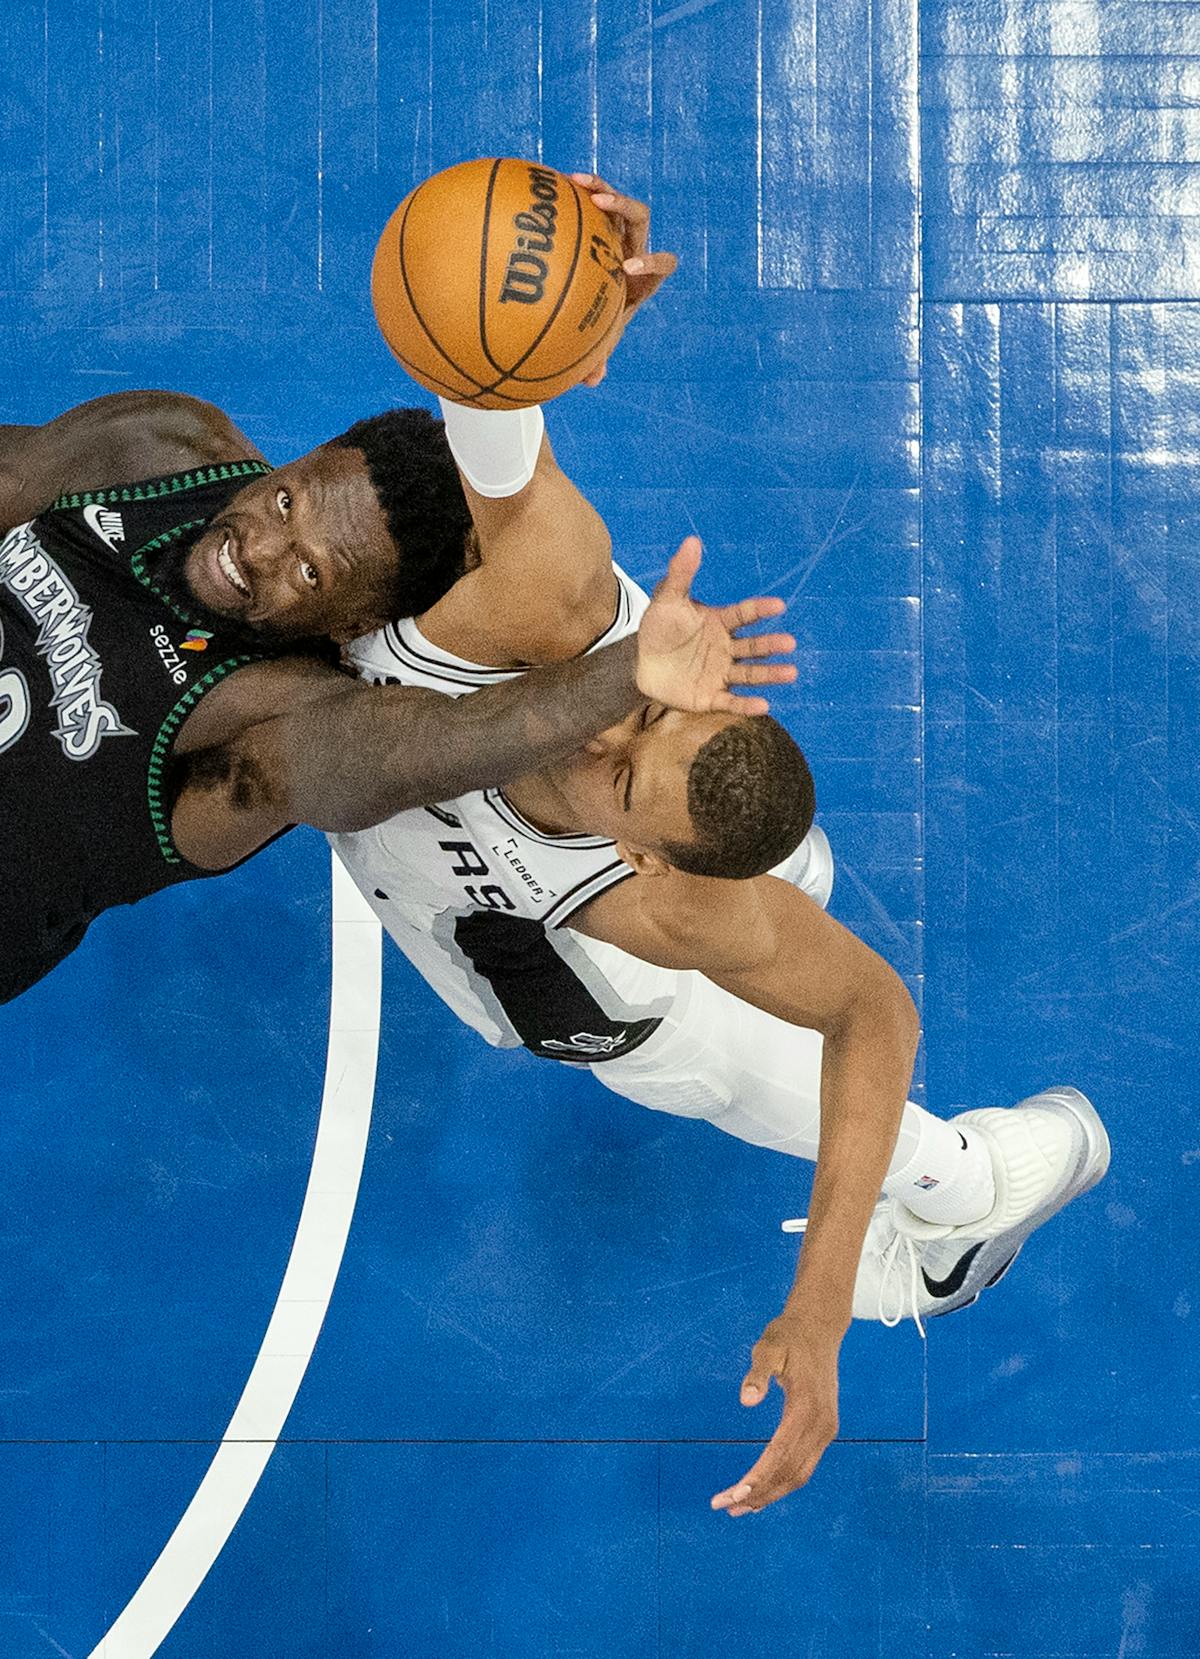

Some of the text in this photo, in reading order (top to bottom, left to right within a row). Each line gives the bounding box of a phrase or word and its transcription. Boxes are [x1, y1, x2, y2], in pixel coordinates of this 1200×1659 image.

[499, 166, 559, 305] Wilson
[99, 511, 126, 542] NIKE
[149, 623, 188, 685] sezzle
[503, 850, 544, 895] LEDGER
